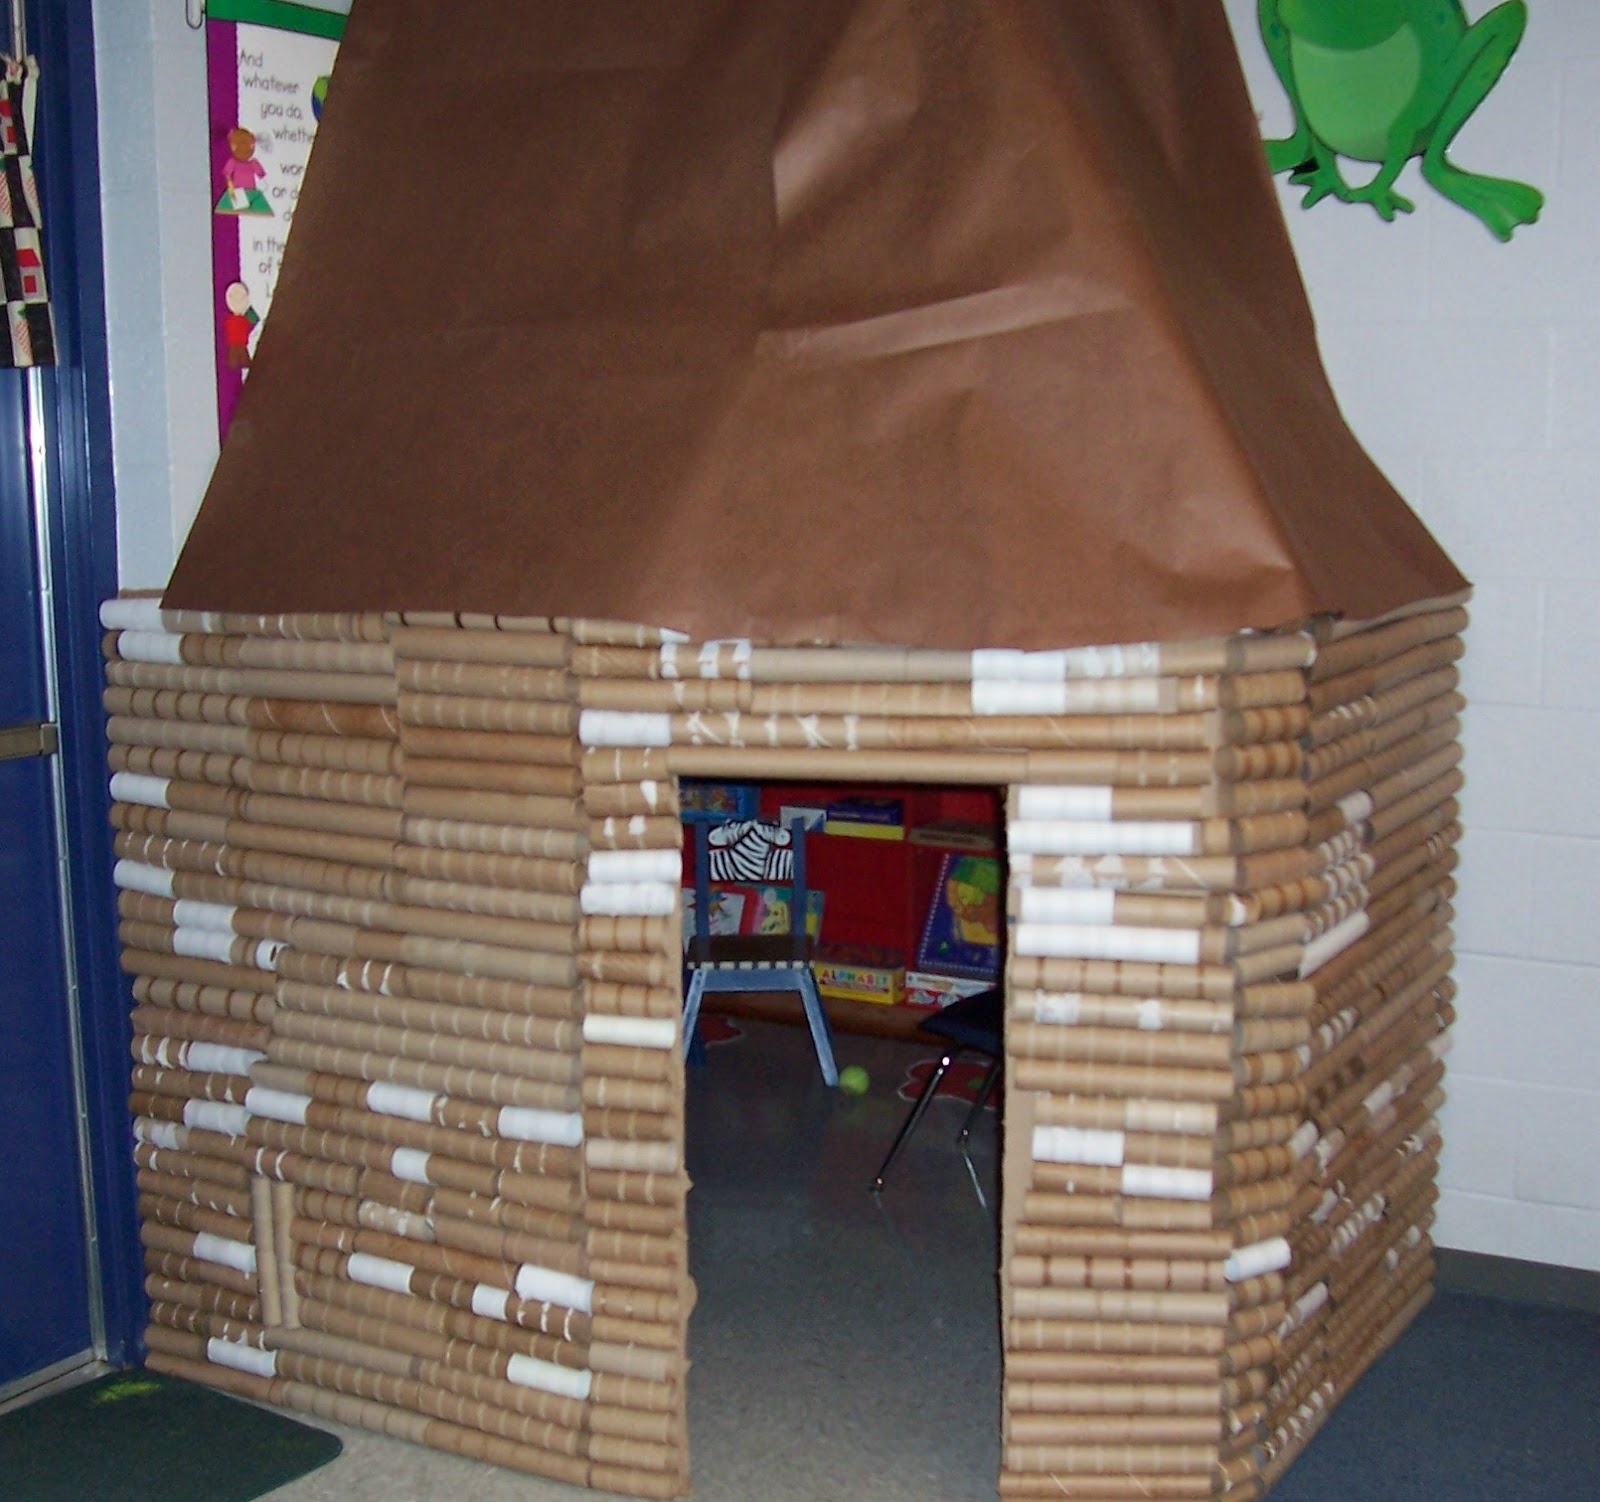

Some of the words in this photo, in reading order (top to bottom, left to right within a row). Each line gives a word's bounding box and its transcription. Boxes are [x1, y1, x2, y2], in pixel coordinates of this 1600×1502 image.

[240, 49, 263, 68] And
[243, 72, 299, 94] whatever
[261, 103, 283, 119] you
[272, 186, 286, 198] or
